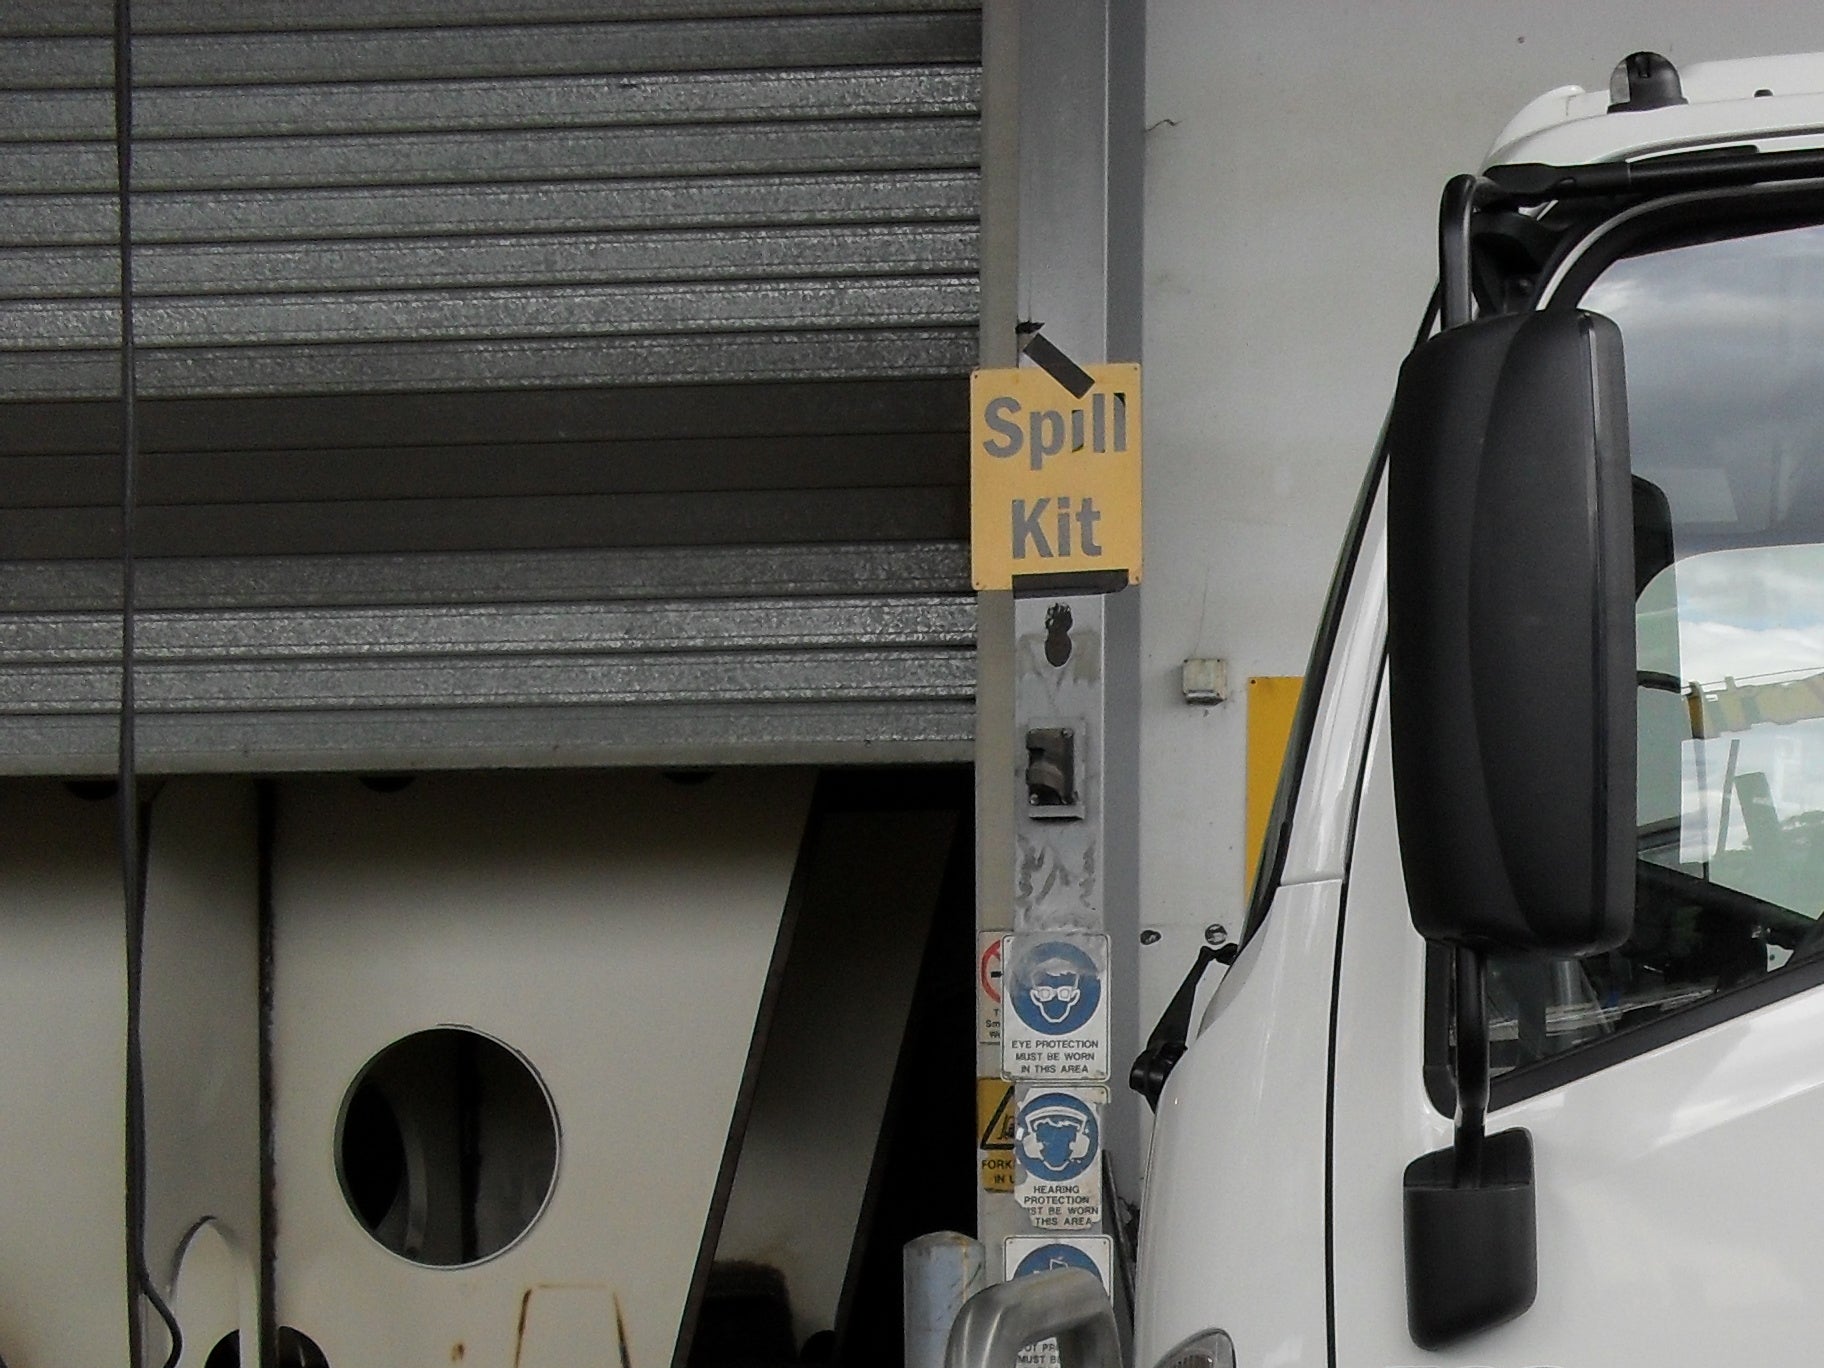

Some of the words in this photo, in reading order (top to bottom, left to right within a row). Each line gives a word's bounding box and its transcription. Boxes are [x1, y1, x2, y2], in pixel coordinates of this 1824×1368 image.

[983, 392, 1127, 471] Spill
[1012, 497, 1102, 560] Kit
[1012, 1040, 1032, 1048] EYE
[1035, 1040, 1098, 1048] PROTECTION
[1016, 1052, 1043, 1060] MUST
[1047, 1052, 1060, 1060] BE
[1064, 1052, 1095, 1060] WORN
[1021, 1065, 1030, 1073] IN
[1035, 1065, 1056, 1073] THIS
[1061, 1065, 1089, 1073] AREA
[994, 1175, 1005, 1184] IN
[1033, 1185, 1080, 1194] HEARING
[1024, 1196, 1089, 1204] PROTECTION
[1048, 1207, 1062, 1215] BE
[1068, 1207, 1098, 1215] WORN
[1035, 1217, 1058, 1225] THIS
[1064, 1217, 1092, 1225] AREA
